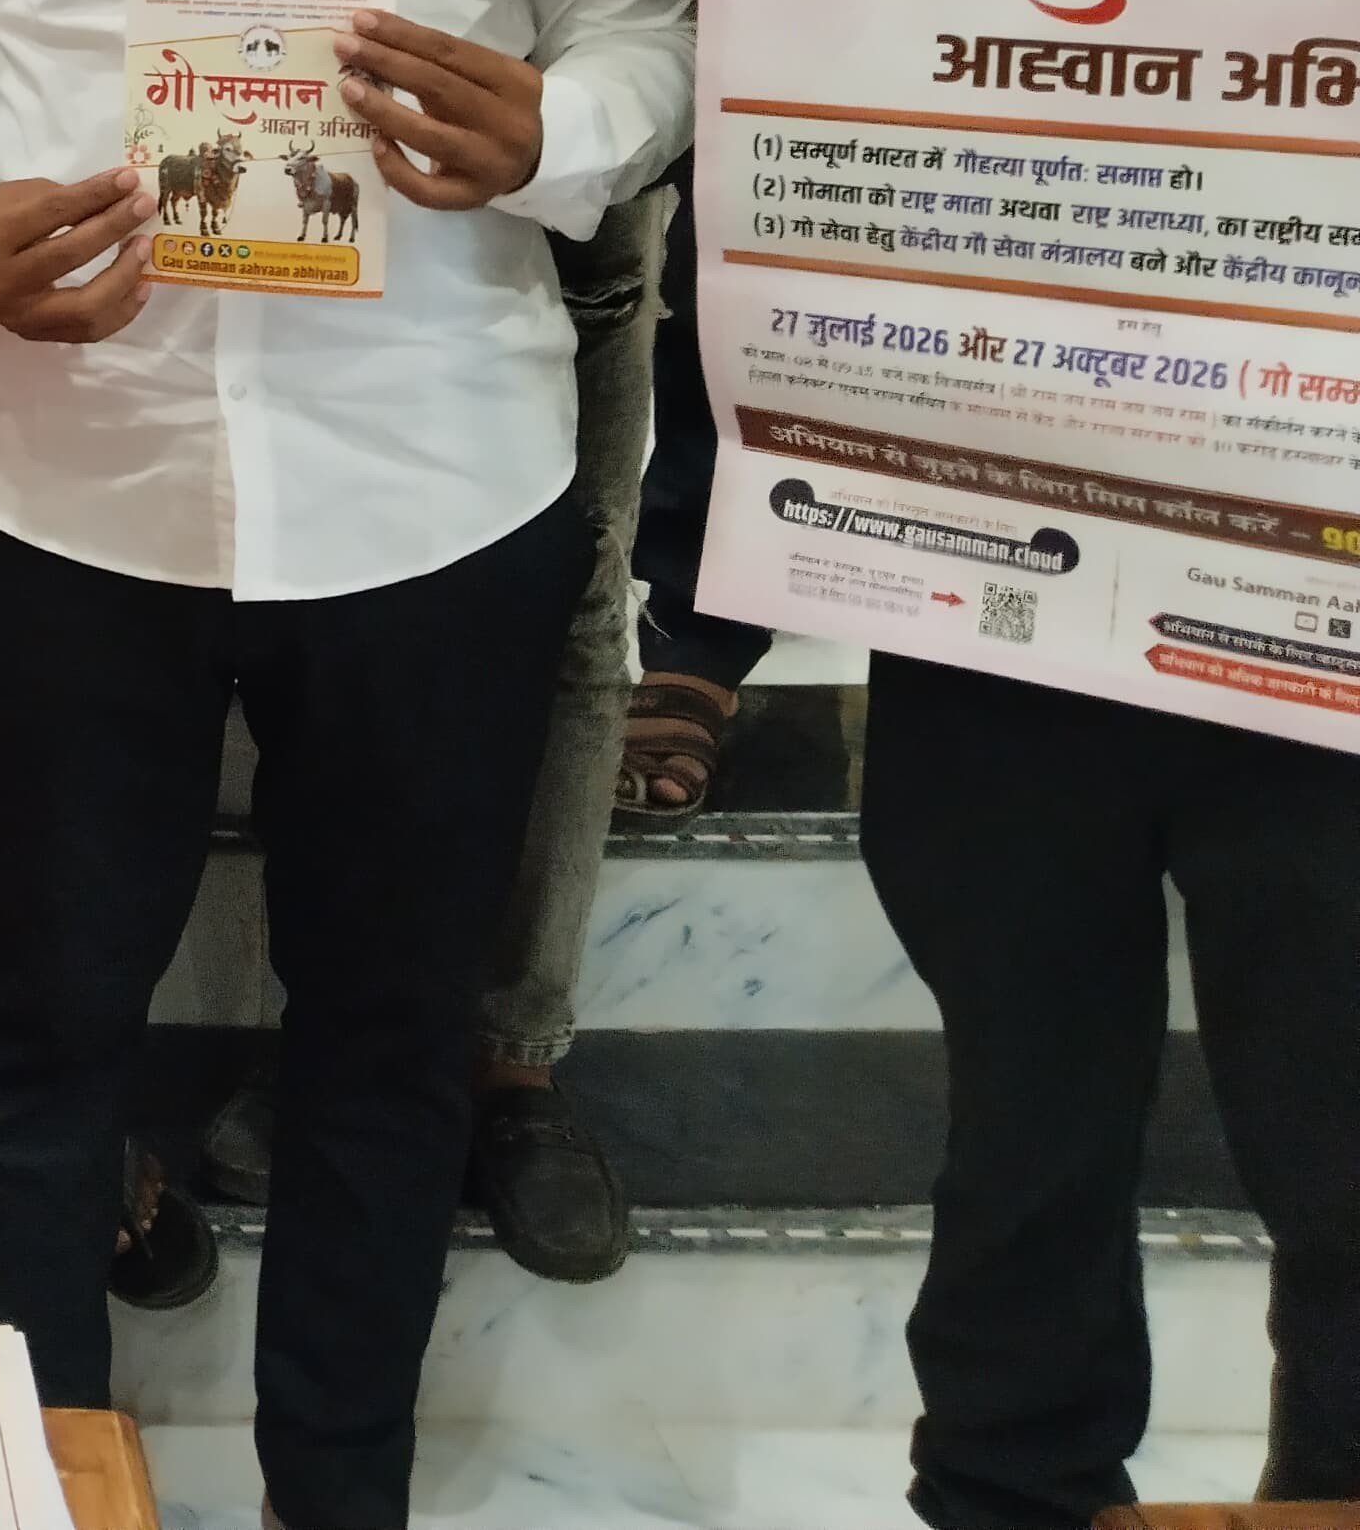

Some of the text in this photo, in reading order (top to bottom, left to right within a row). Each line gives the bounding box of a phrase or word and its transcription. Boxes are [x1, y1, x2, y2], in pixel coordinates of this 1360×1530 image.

[202, 74, 329, 126] सम्मान
[753, 133, 783, 162] (1)
[788, 139, 858, 169] सम्पूर्ण
[861, 145, 919, 169] भारत
[921, 145, 945, 171] में
[953, 148, 1025, 177] गौहत्या
[1095, 164, 1164, 188] समाप्त
[752, 172, 786, 202] (2)
[791, 176, 864, 204] गोमाता
[866, 182, 896, 208] को
[899, 190, 937, 214] राष्ट्र
[941, 193, 993, 216] माता
[998, 198, 1062, 221] अथवा
[1072, 204, 1111, 228] राष्ट्र
[1216, 215, 1249, 237] का
[1253, 215, 1324, 245] राष्ट्रीय
[162, 255, 185, 269] Gau
[186, 258, 237, 274] samman
[292, 263, 349, 281] abhiyaan
[753, 211, 785, 239] (3)
[789, 215, 816, 238] गो
[818, 217, 861, 243] सेवा
[864, 221, 896, 253] हेतु
[992, 234, 1036, 260] सेवा
[1040, 238, 1124, 269] मंत्रालय
[1129, 247, 1168, 273] बने
[1173, 250, 1218, 278] और
[771, 307, 799, 336] 27
[804, 312, 877, 348] जुलाई
[882, 322, 949, 356] 2026
[957, 325, 1008, 363] और
[1012, 338, 1046, 368] 27
[1051, 343, 1149, 388] अक्टूबर
[1153, 355, 1227, 390] 2026
[1259, 361, 1293, 397] गो
[769, 421, 876, 461] अभियान
[879, 442, 908, 467] से
[782, 498, 1064, 571] https://www.gausamman.cloud
[1186, 566, 1320, 607] Gau Samman
